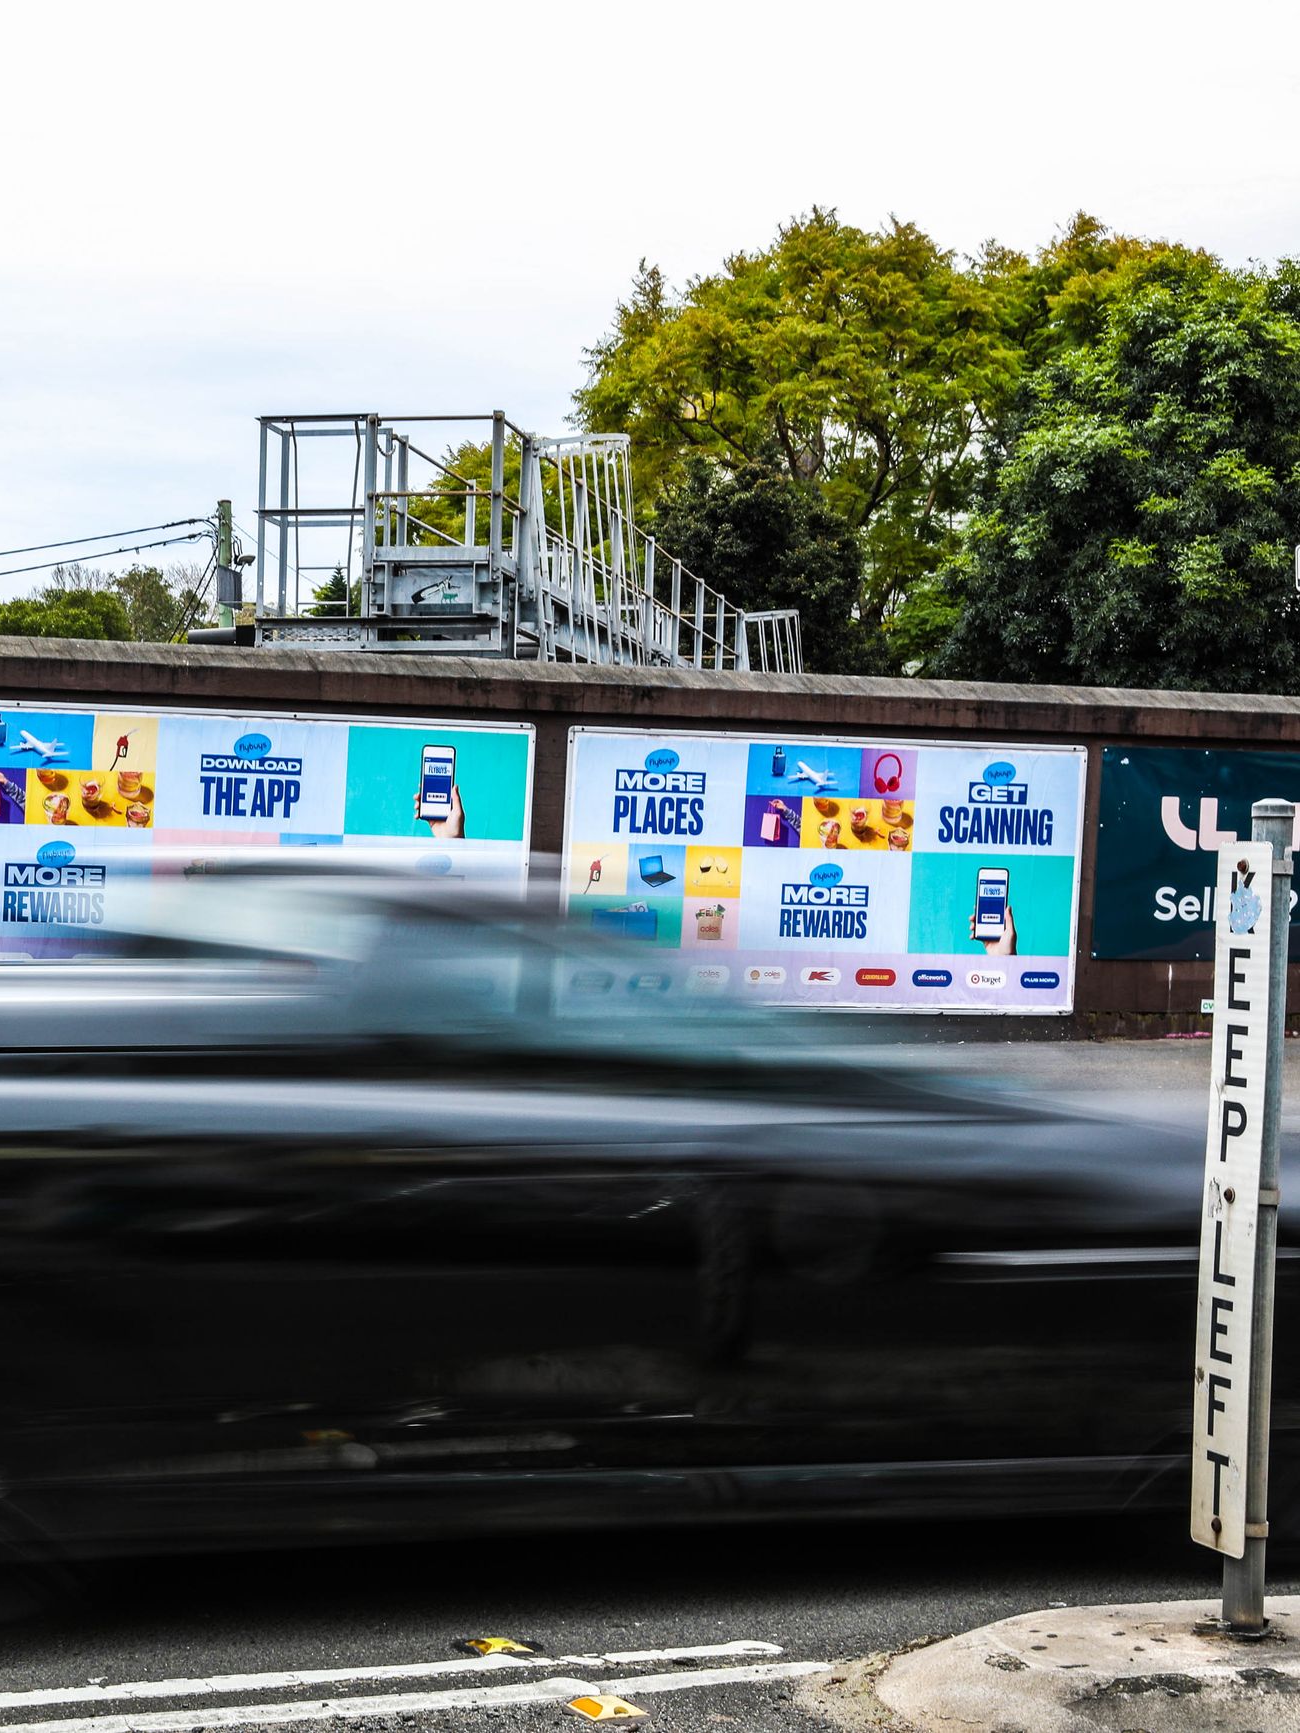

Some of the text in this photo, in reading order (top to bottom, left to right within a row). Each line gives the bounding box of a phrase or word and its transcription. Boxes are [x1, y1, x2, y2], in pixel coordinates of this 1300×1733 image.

[238, 740, 267, 753] flybuys
[202, 757, 301, 772] DOWNLOAD
[618, 771, 703, 792] MORE
[200, 776, 301, 818] THE APP
[971, 784, 1026, 803] GET
[613, 795, 704, 836] PLACES
[938, 806, 1053, 846] SCANNING
[7, 865, 103, 887] MORE
[2, 890, 105, 924] REWARDS
[784, 886, 866, 906] MORE
[779, 908, 868, 939] REWARDS
[981, 975, 1001, 986] Target
[1206, 1220, 1236, 1516] LEFT
